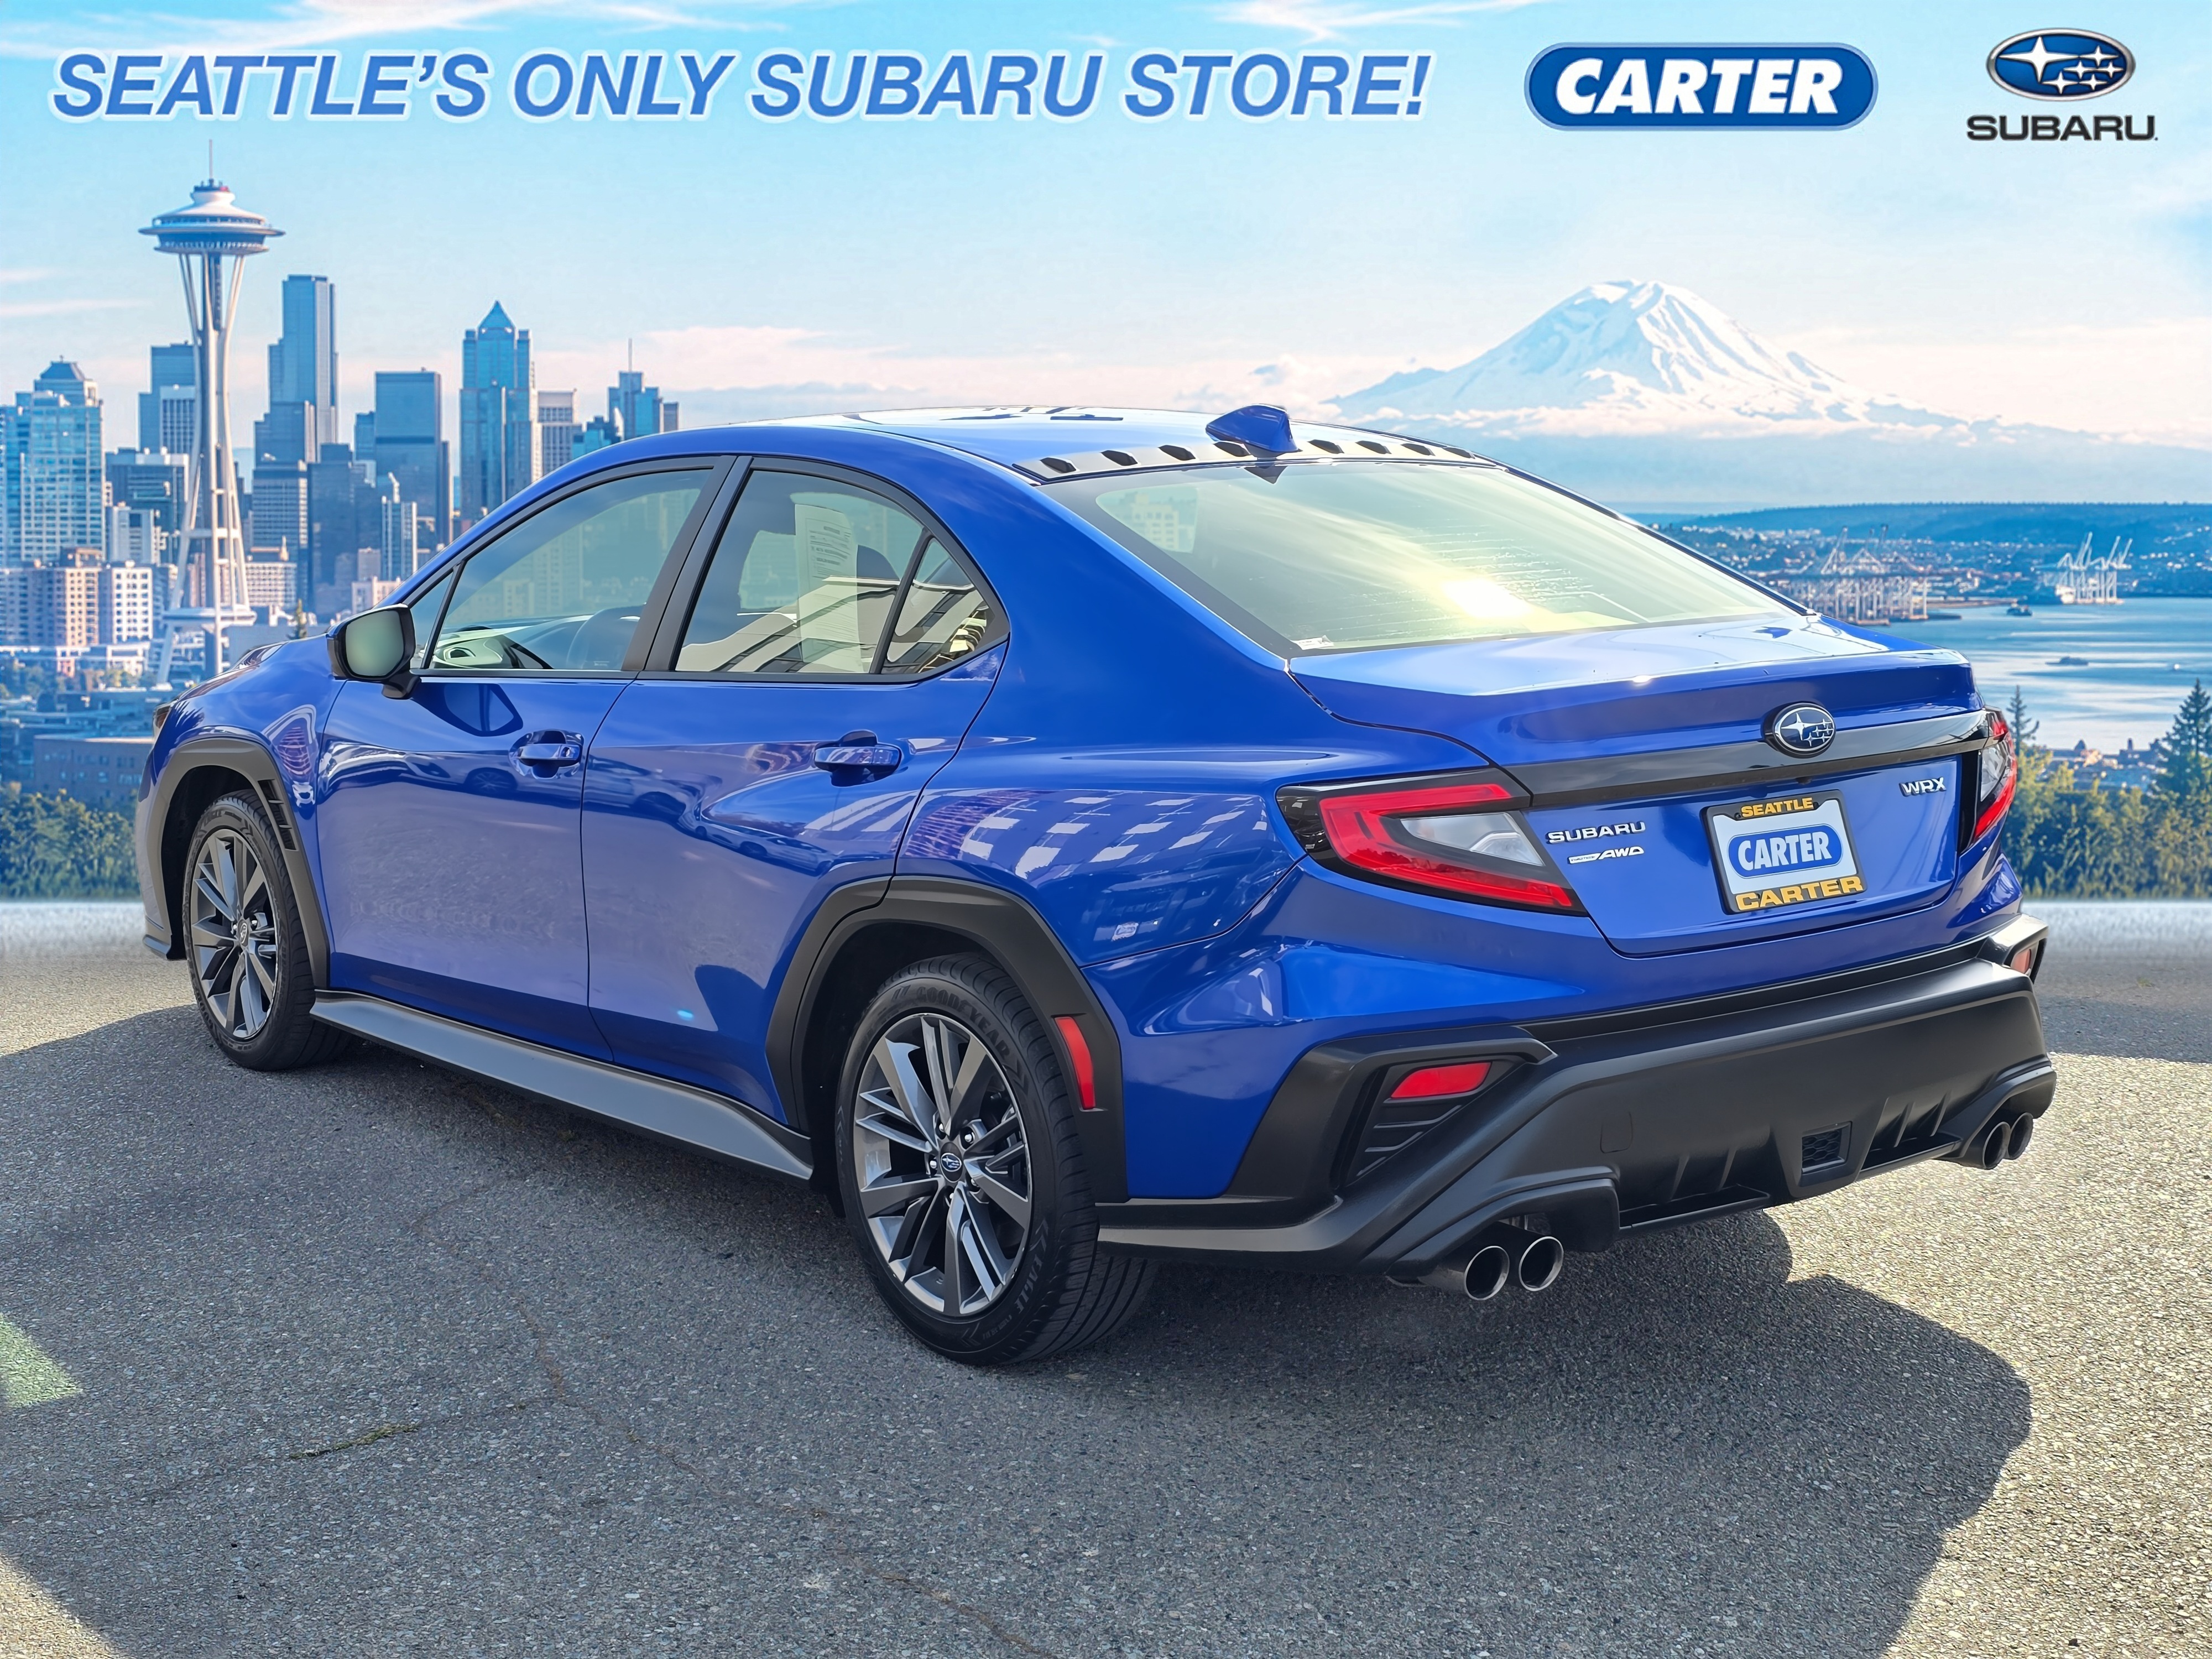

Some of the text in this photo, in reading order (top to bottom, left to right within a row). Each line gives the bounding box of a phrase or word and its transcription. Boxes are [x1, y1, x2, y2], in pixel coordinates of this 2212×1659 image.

[1900, 776, 1947, 797] WRX
[1741, 797, 1814, 817] SEATTLE
[1546, 821, 1646, 844] SUBARU
[1598, 846, 1645, 861] AWD
[1738, 831, 1833, 872] CARTER
[1736, 876, 1864, 911] CARTER
[916, 985, 1011, 1061] GOODYEAR
